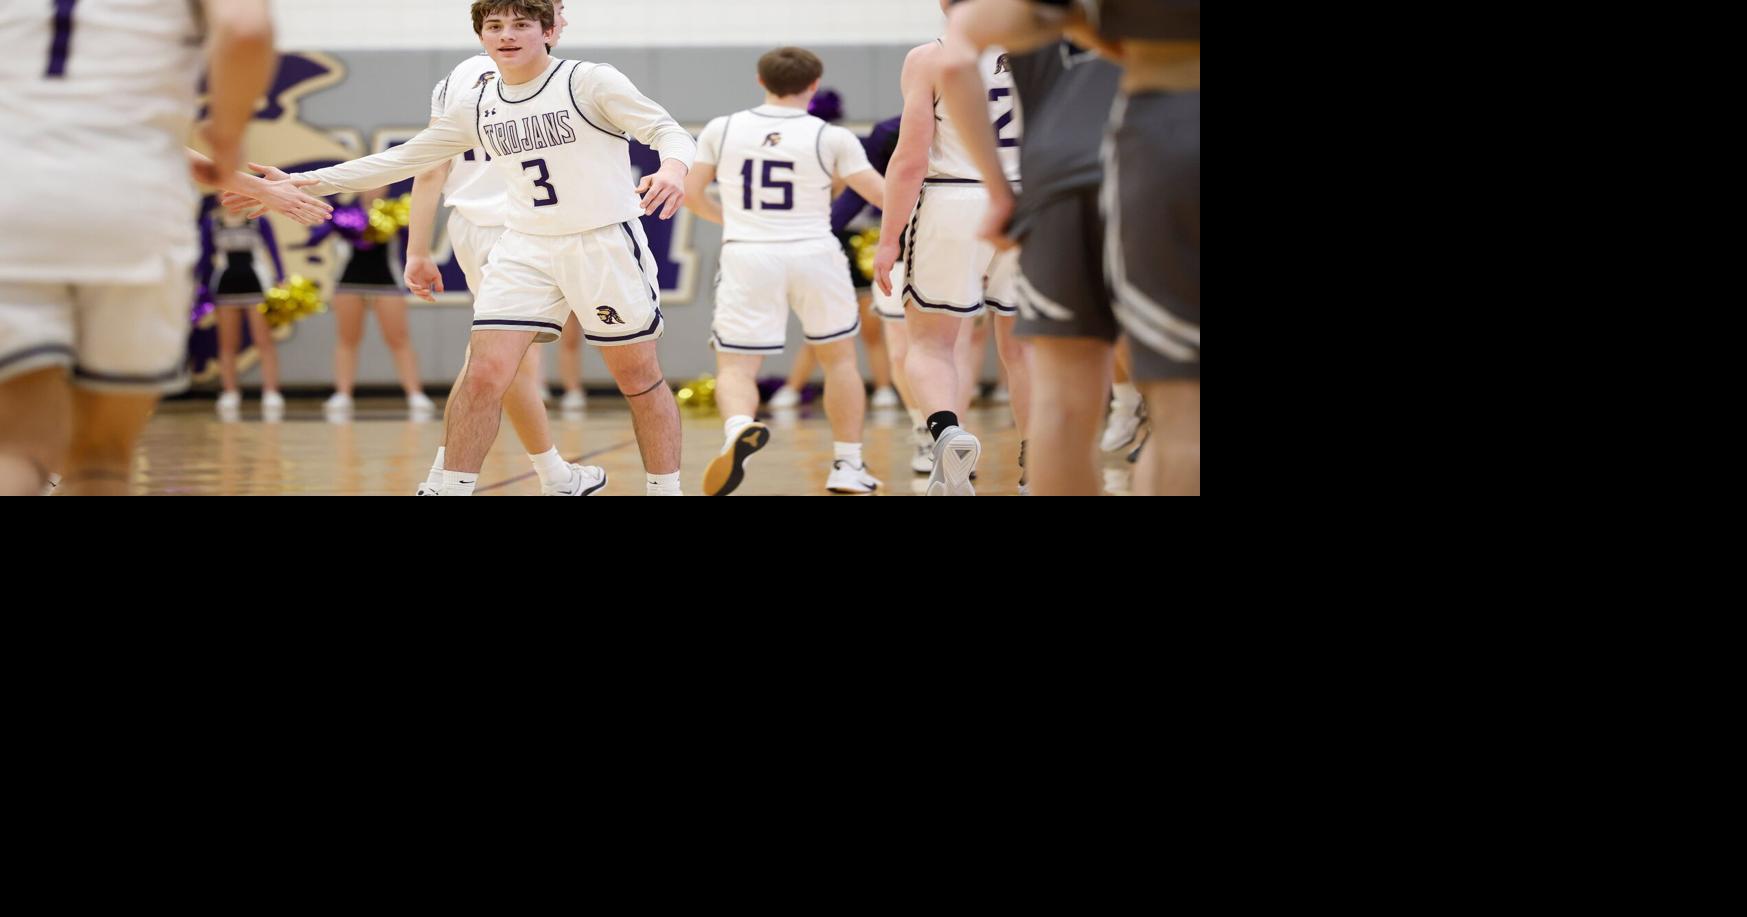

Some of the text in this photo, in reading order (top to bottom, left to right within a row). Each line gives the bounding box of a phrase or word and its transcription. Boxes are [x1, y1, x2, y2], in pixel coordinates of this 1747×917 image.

[483, 110, 576, 156] TROJANS
[521, 158, 558, 207] 3
[740, 159, 794, 210] 15
